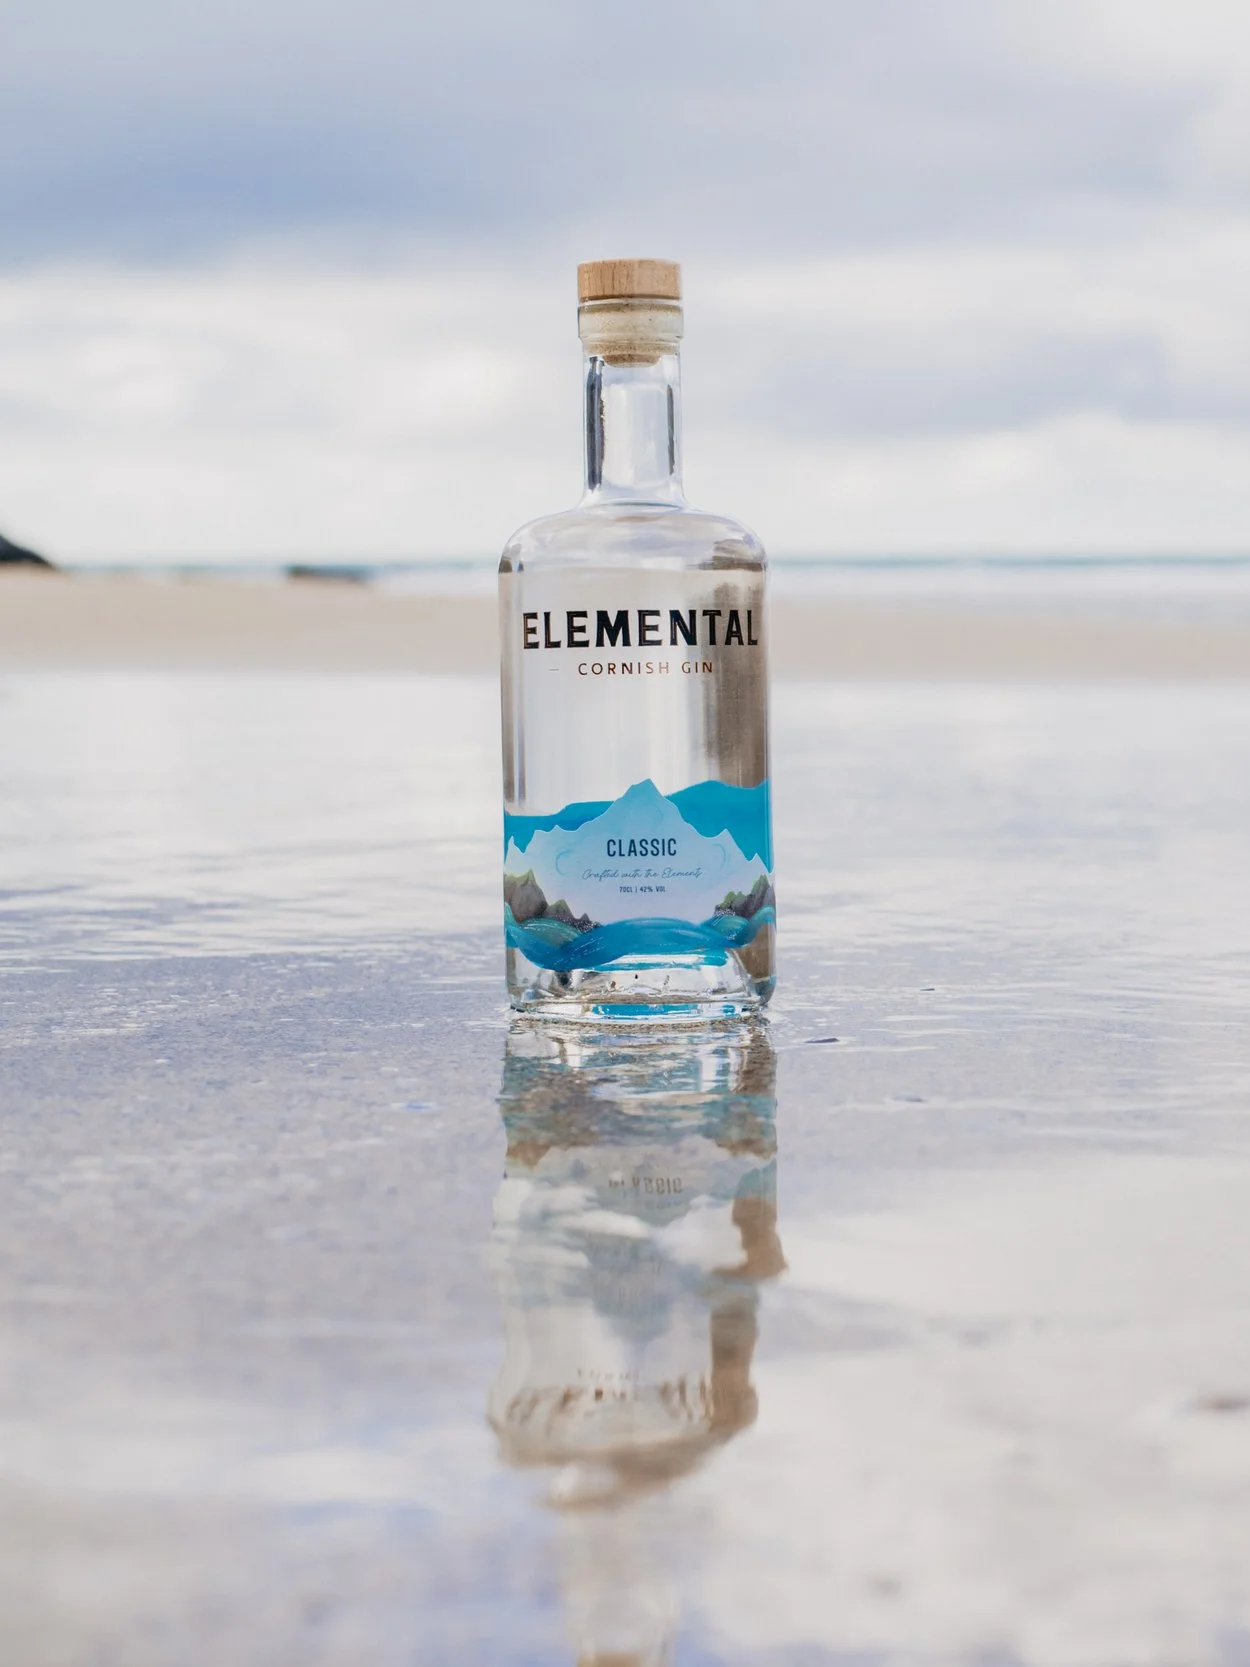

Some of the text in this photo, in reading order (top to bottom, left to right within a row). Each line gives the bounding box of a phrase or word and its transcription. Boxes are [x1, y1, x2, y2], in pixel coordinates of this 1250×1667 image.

[522, 609, 758, 649] ELEMENTAL
[578, 660, 713, 676] CORNISH GIN
[606, 838, 677, 857] CLASSIC
[582, 868, 619, 881] Crafted
[621, 868, 641, 879] with
[643, 867, 659, 878] the
[639, 885, 653, 893] 42%
